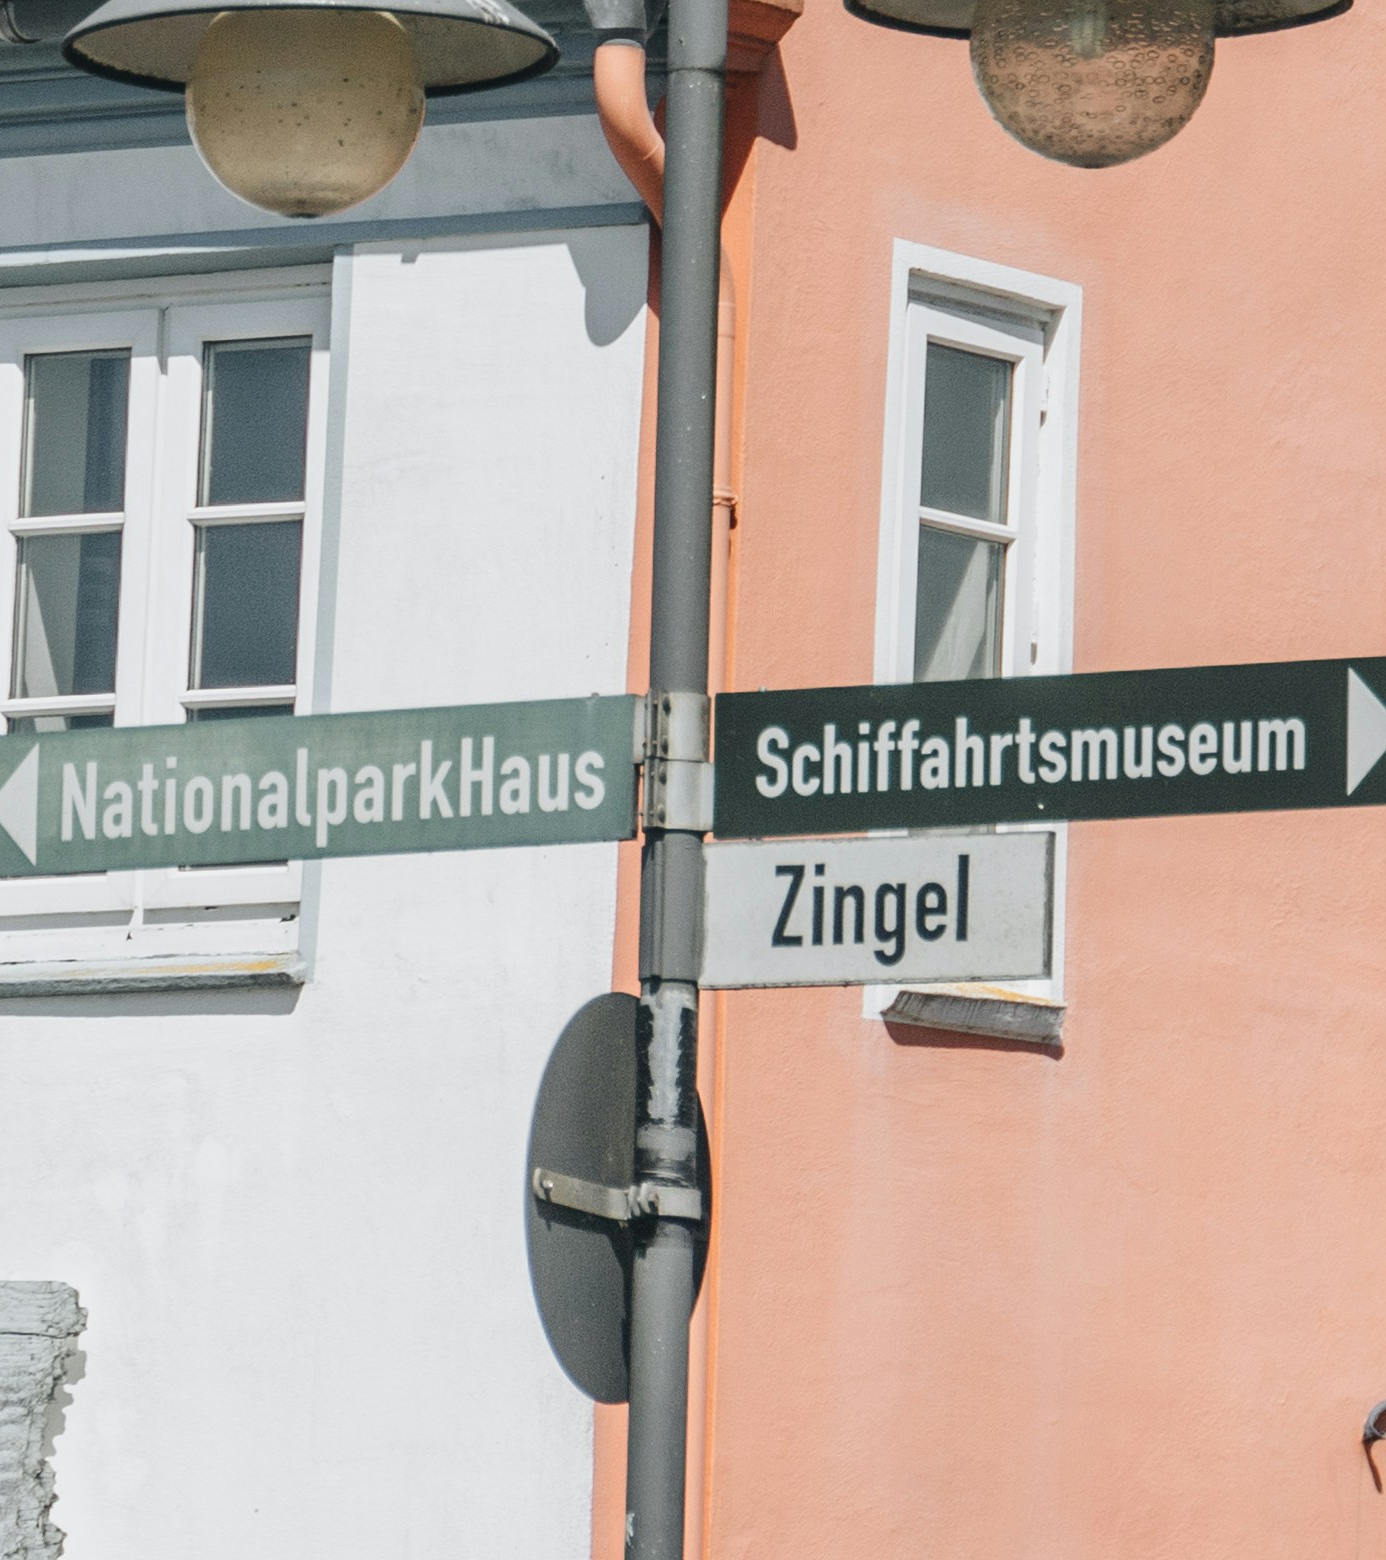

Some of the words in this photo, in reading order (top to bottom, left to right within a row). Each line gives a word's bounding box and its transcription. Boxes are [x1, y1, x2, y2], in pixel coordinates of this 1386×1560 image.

[59, 737, 605, 845] NationalparkHaus
[753, 712, 1306, 801] Schiffahrtsmuseum
[770, 854, 971, 966] Zingel
